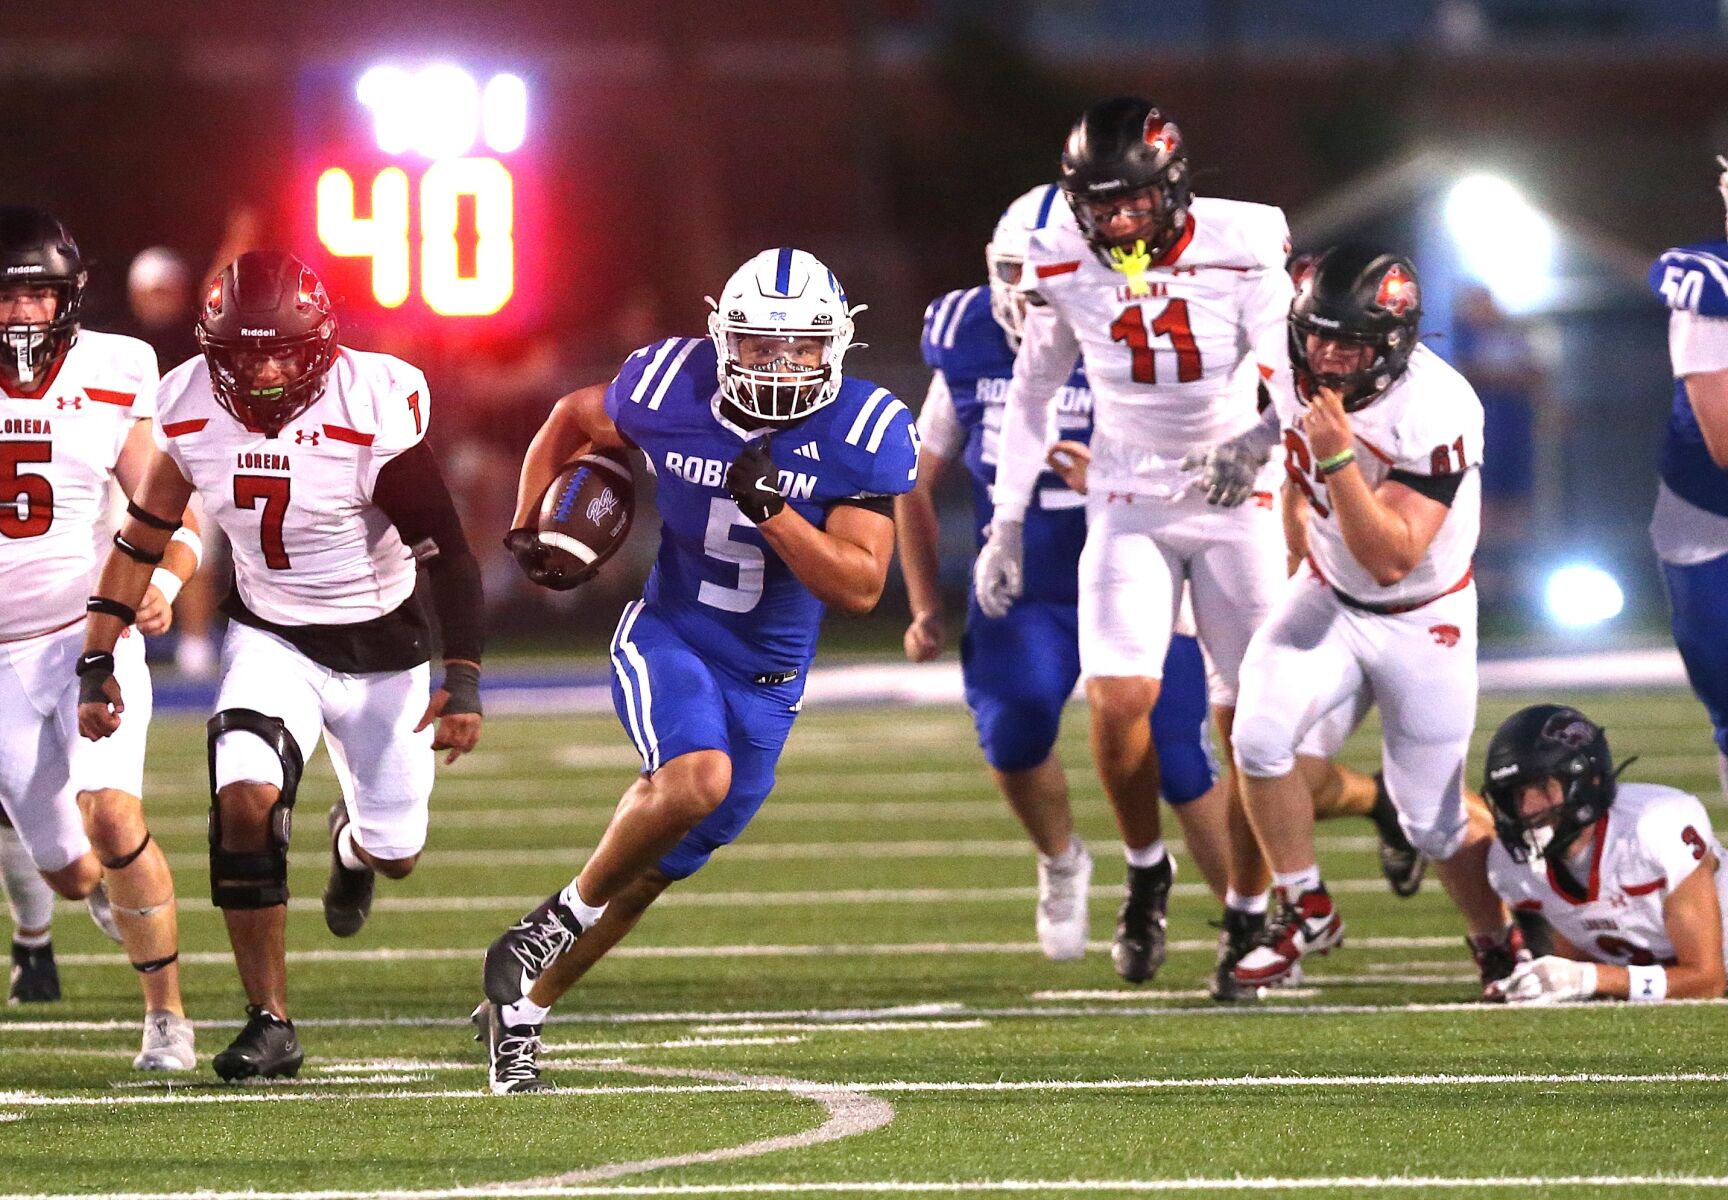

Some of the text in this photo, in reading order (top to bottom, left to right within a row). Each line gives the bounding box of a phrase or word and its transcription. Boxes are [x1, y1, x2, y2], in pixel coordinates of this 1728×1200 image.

[317, 157, 514, 316] 40
[240, 328, 276, 337] Riddell
[1110, 297, 1203, 384] 11
[0, 440, 54, 539] 5
[237, 452, 290, 471] LORENA
[233, 474, 292, 570] 7
[697, 496, 765, 613] 5
[1681, 825, 1707, 860] 3
